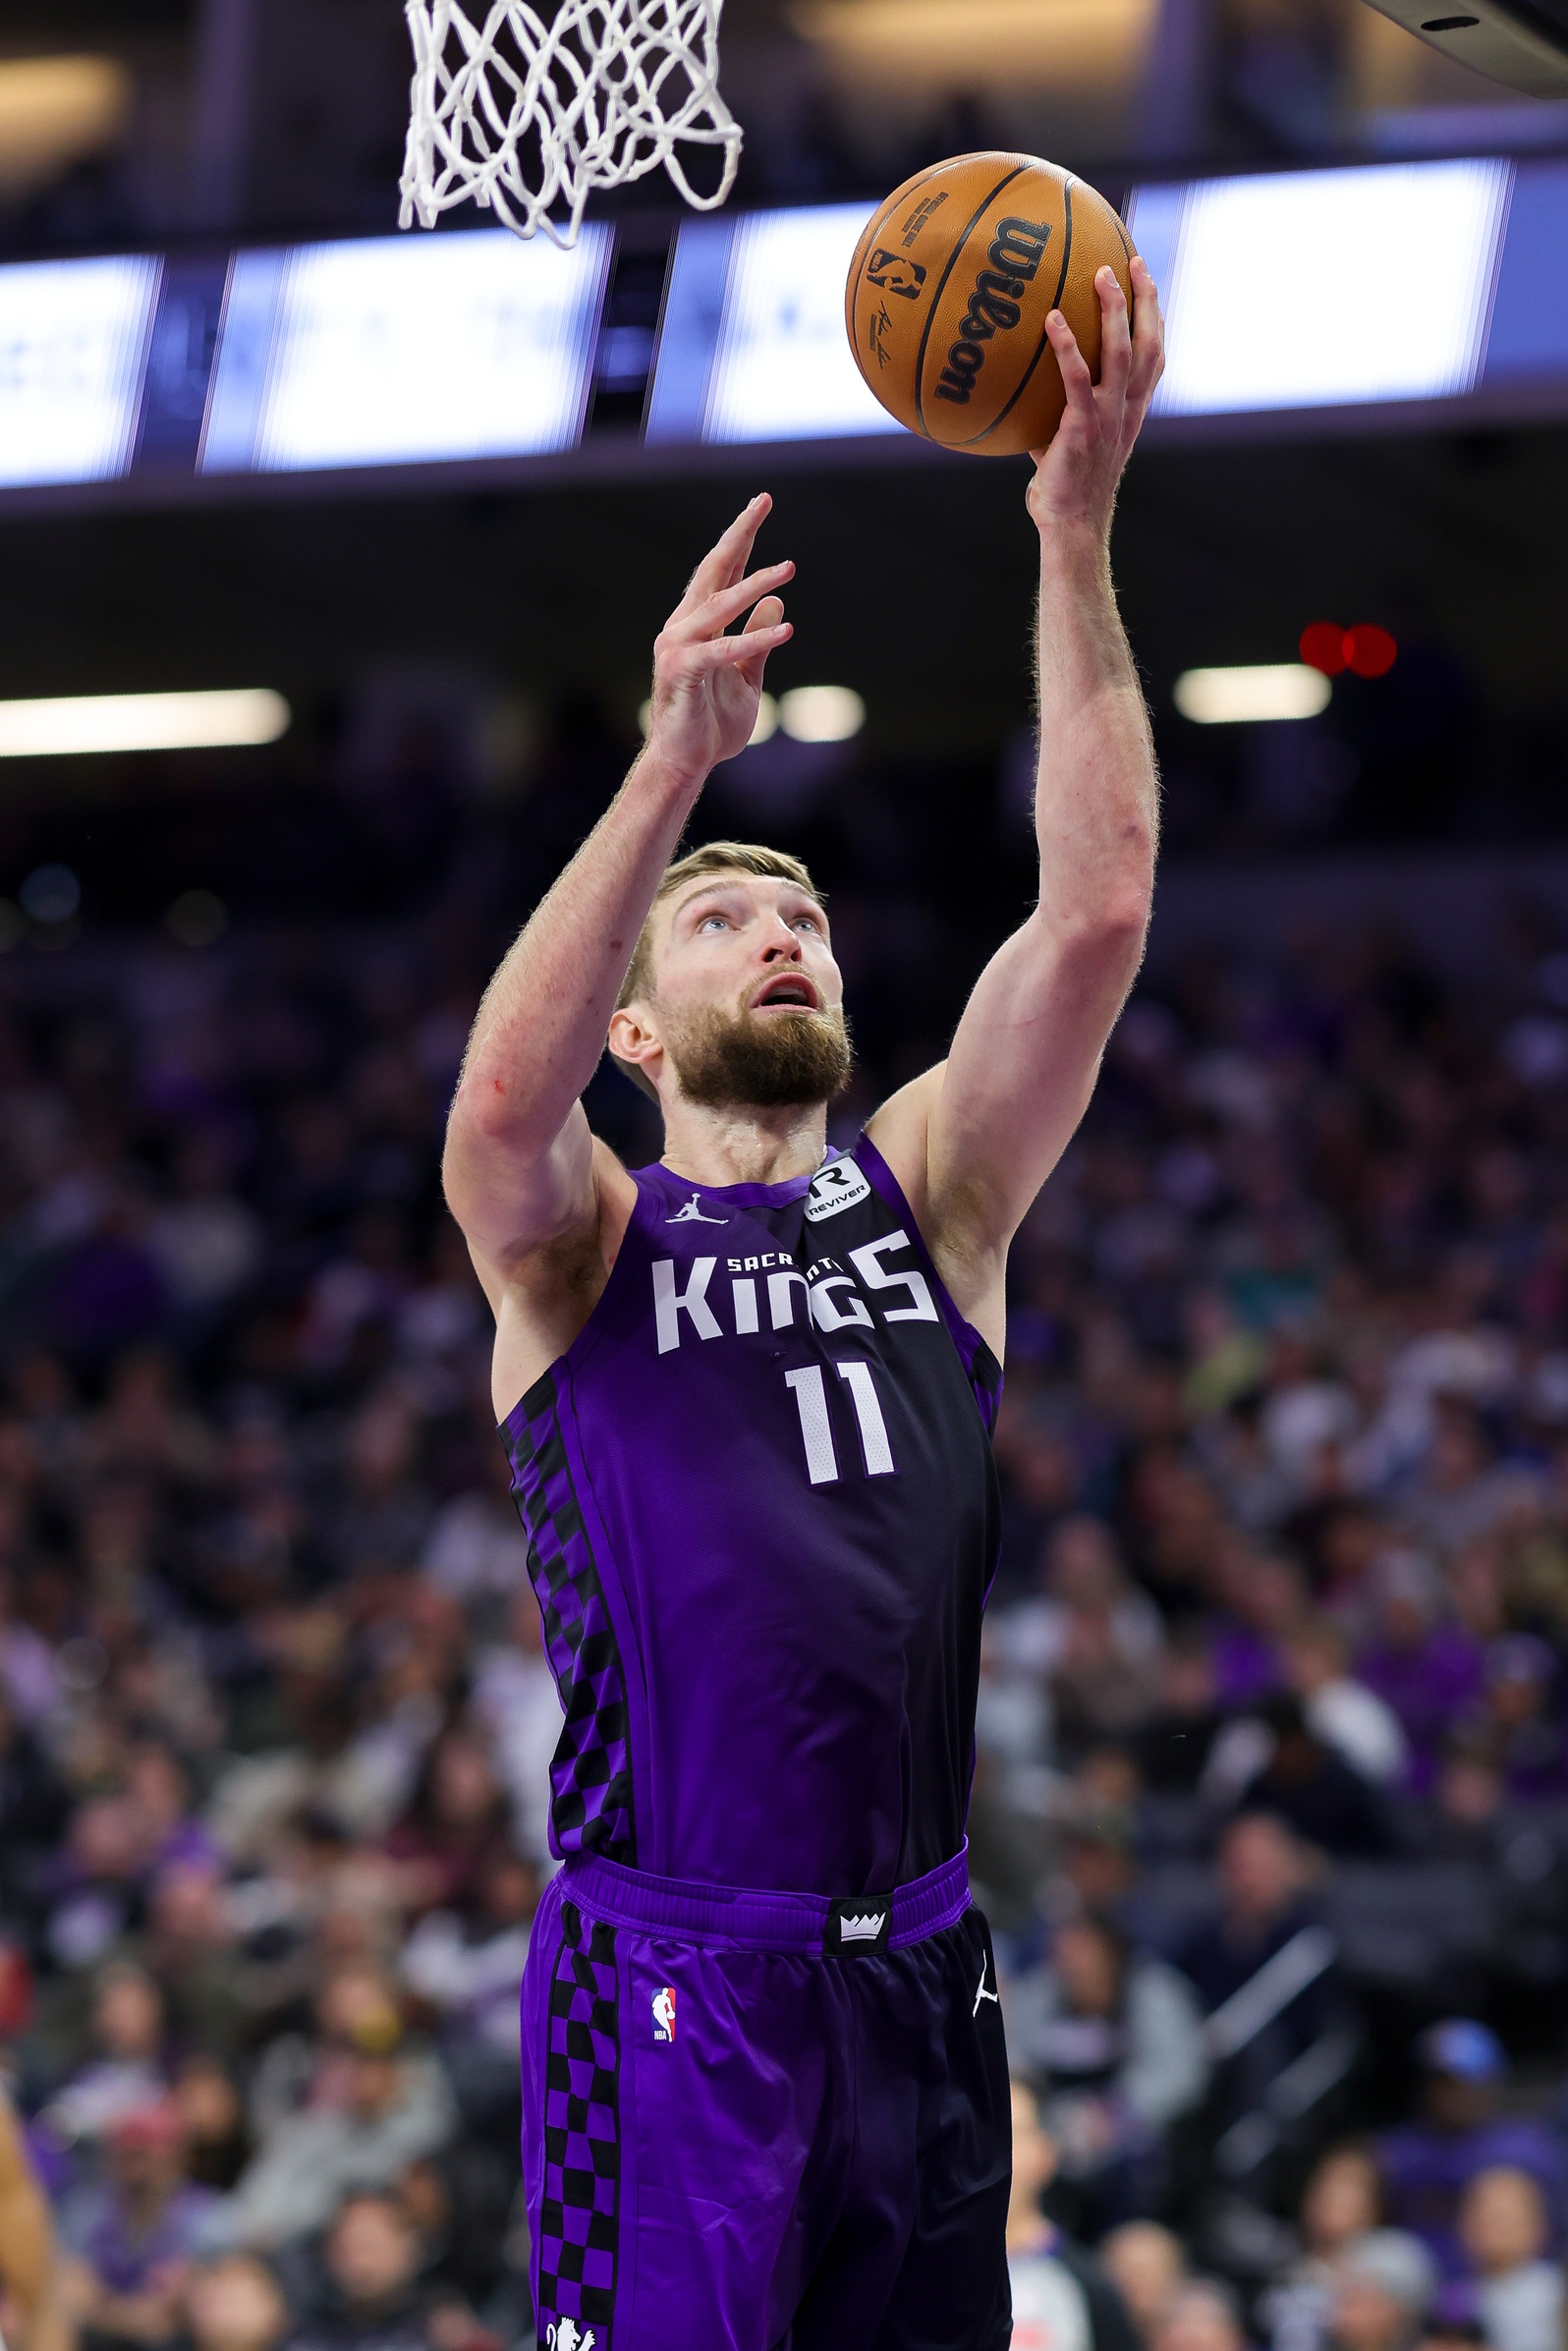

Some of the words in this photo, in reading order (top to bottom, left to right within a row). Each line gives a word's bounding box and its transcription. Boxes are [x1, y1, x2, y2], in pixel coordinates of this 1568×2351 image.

[933, 216, 1053, 405] Wilson
[809, 1184, 866, 1216] REVIVER
[784, 1362, 895, 1485] 11
[653, 2030, 667, 2041] NBA
